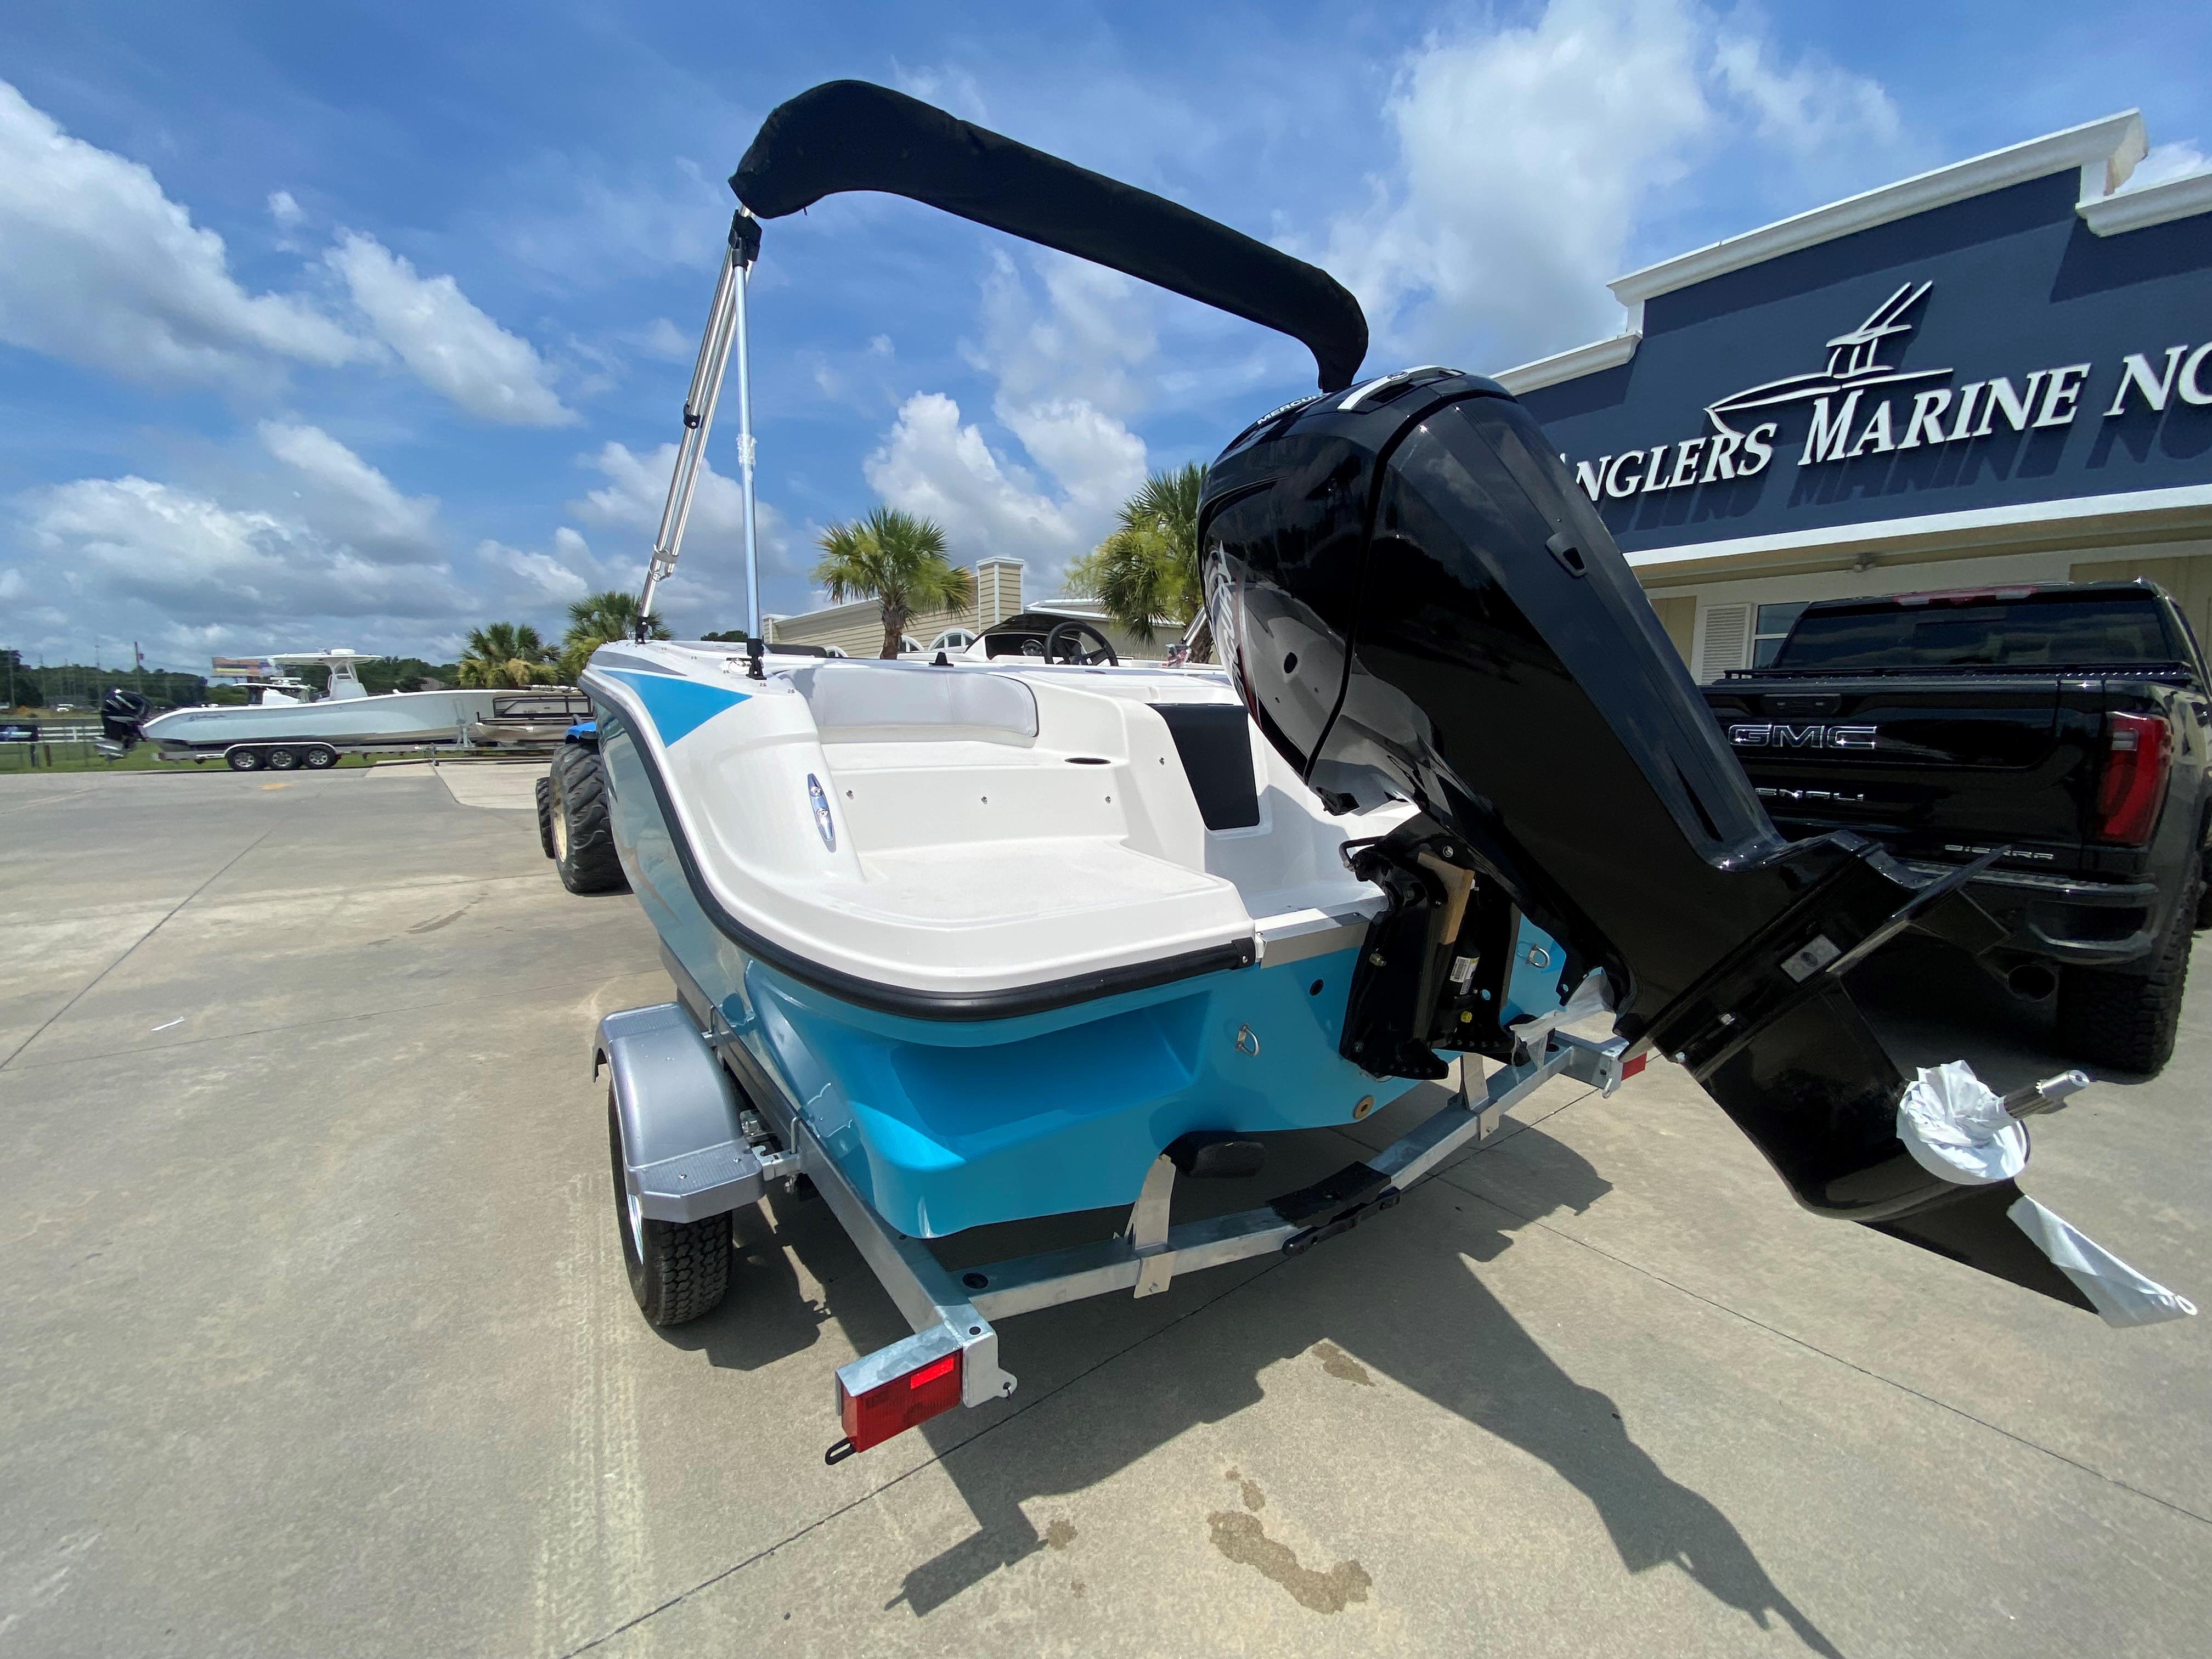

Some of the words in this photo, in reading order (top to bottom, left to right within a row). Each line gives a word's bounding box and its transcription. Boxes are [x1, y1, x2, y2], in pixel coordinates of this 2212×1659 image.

[1257, 392, 1324, 425] MERCU
[1559, 421, 1778, 501] NGLERS
[1797, 363, 2092, 466] MARINE
[1728, 724, 1877, 750] GMC
